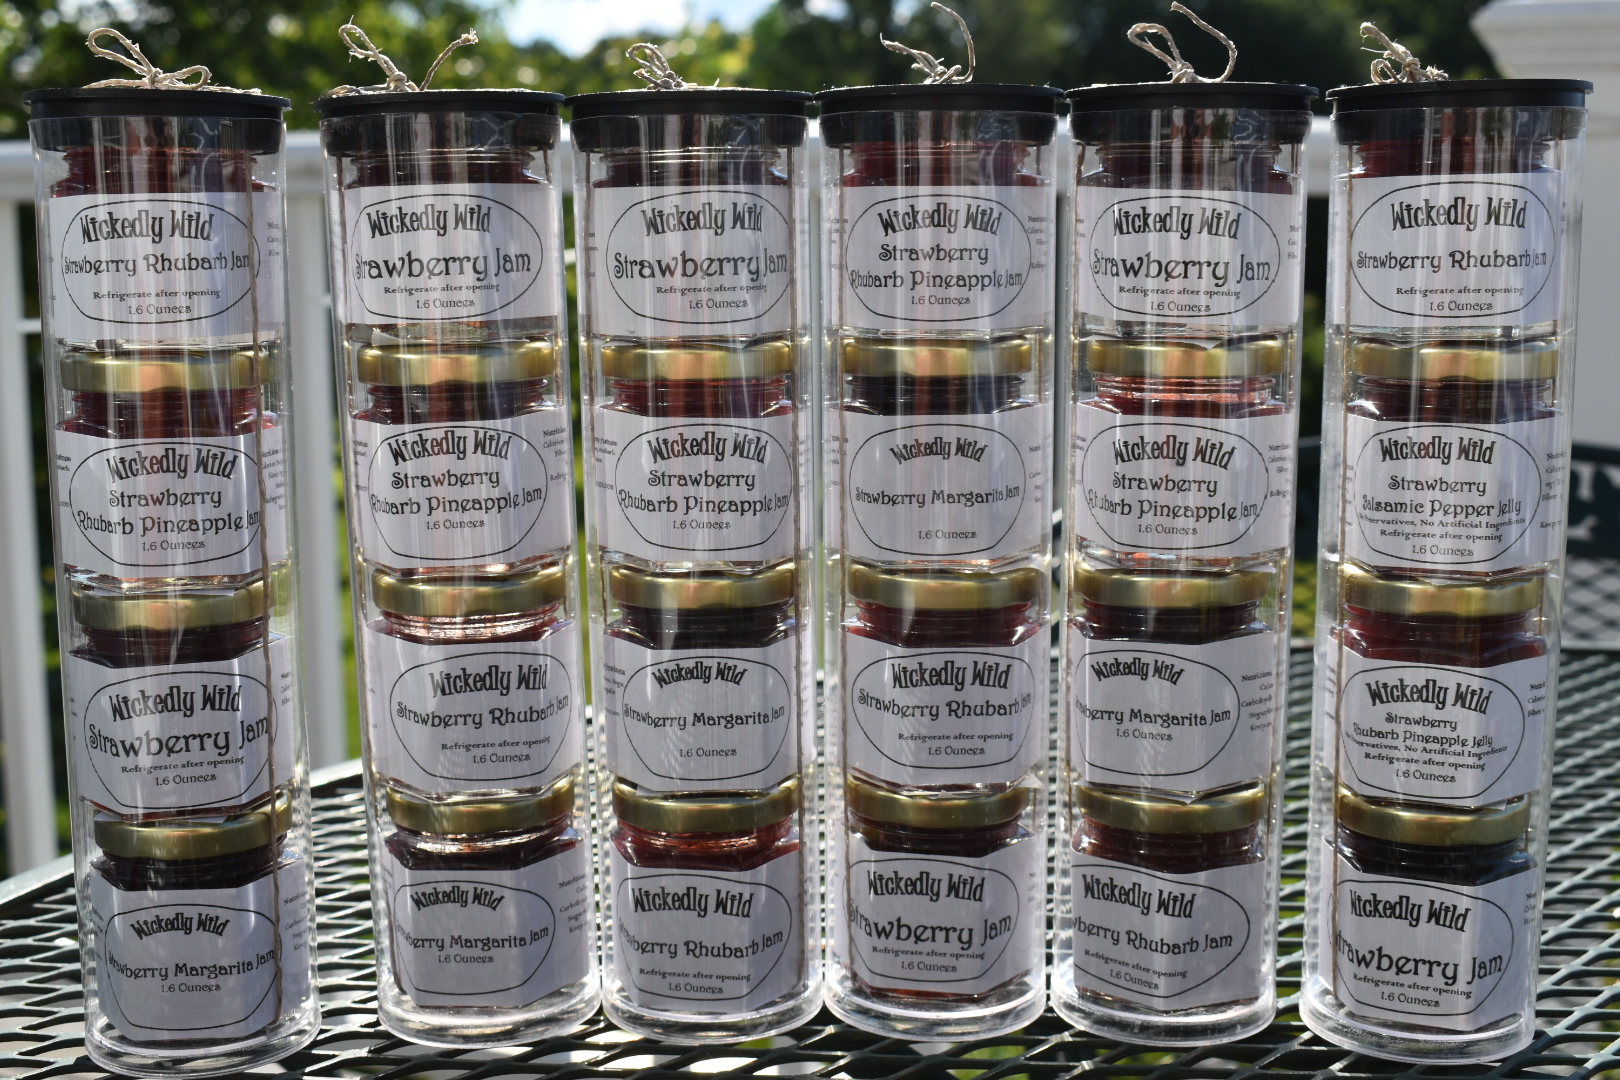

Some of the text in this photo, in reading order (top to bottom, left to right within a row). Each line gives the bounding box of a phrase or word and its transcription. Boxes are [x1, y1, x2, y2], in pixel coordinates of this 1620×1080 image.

[80, 209, 214, 244] Wickedly Wild
[367, 204, 492, 239] Wickedly Wild
[641, 203, 763, 236] Wickedly Wild
[877, 203, 1002, 236] Wickedly Wild
[1113, 206, 1241, 240] Wickedly Wild
[1391, 197, 1528, 231] Wickedly Wild
[64, 253, 227, 276] Strawberry Rhubarb
[494, 248, 531, 277] Jam
[614, 249, 787, 282] Strawberry Jam
[879, 244, 989, 264] Strawberry
[1357, 250, 1531, 273] Strawberry Rhubarb
[850, 270, 1003, 292] Rhubarb Pineapple
[1094, 249, 1270, 288] Strawberry Jam
[93, 291, 152, 301] Refrigerate
[182, 289, 221, 298] opening
[1396, 287, 1454, 297] Refrigerate
[1485, 286, 1524, 296] opening
[128, 304, 191, 315] 1.6 Ounces
[1151, 301, 1210, 313] 1.6 Ounces
[1430, 301, 1493, 312] 1.6 Ounces
[387, 430, 468, 466] Wickedly
[472, 430, 512, 460] Wild
[647, 431, 728, 464] Wickedly
[731, 433, 768, 464] Wild
[889, 437, 988, 465] Wickedly Wild
[1113, 435, 1189, 466] Wickedly
[1192, 437, 1237, 470] Wild
[1379, 436, 1497, 465] Wickedly Wild
[106, 448, 190, 483] Wickedly
[194, 448, 238, 480] Wild
[391, 470, 500, 489] Strawberry
[648, 470, 756, 491] Strawberry
[1113, 472, 1218, 497] Strawberry
[1388, 475, 1486, 496] Strawberry
[110, 489, 222, 508] Strawberry
[426, 487, 542, 516] Pineapple Jam
[618, 489, 772, 517] Rhubarb Pineapple
[855, 487, 1003, 508] Strawberry Margarita
[1429, 497, 1521, 518] Pepper Jelly
[77, 510, 243, 537] Rhubarb Pineapple
[1138, 499, 1237, 523] Pineapple
[426, 519, 485, 530] 1.6 Ounces
[672, 519, 731, 530] 1.6 Ounces
[1380, 529, 1503, 543] Refrigerate after opening
[1437, 520, 1482, 529] Artificial
[1412, 545, 1474, 557] 1.6 Ounces
[429, 664, 547, 698] Wickedly Wild
[652, 661, 748, 689] Wickedly Wild
[892, 660, 1012, 692] Wickedly Wild
[1091, 657, 1185, 685] Wickedly Wild
[109, 685, 241, 722] Wickedly Wild
[858, 688, 1019, 721] Strawberry Rhubarb
[1365, 679, 1449, 710] Wickedly
[1451, 683, 1493, 715] Wild
[397, 701, 554, 729] Strawberry Rhubarb
[624, 704, 770, 730] Strawberry Margarita
[1129, 709, 1231, 728] Margarita Jam
[1385, 712, 1458, 732] Strawberry
[89, 716, 268, 758] Strawberry Jam
[898, 732, 1013, 743] Refrigerate after opening
[1116, 728, 1172, 741] 1.6 Ounces
[1403, 730, 1493, 747] Pineapple Jelly
[928, 746, 985, 756] 1.6 Ounces
[1364, 752, 1486, 771] Refrigerate after opening
[1421, 746, 1465, 757] Artificial
[121, 756, 244, 774] Refrigerate after opening
[155, 774, 217, 786] 1.6 Ounces
[410, 886, 505, 911] Wickedly Wild
[867, 871, 985, 902] Wickedly Wild
[1082, 874, 1197, 918] Wickedly Wild
[632, 886, 754, 918] Wickedly Wild
[130, 912, 193, 940] Wickedly
[196, 913, 230, 936] Wild
[1426, 900, 1471, 932] Wild
[450, 926, 549, 951] Margarita Jam
[981, 915, 1011, 946] Jam
[1126, 930, 1233, 955] Rhubarb Jam
[684, 930, 783, 959] Rhubarb Jam
[872, 946, 924, 957] Refrigerate
[950, 951, 985, 961] opening
[174, 962, 253, 979] Margarita
[1466, 954, 1503, 985] Jam
[161, 983, 221, 993] 1.6 Ounces
[668, 983, 724, 994] 1.6 Ounces
[1353, 973, 1472, 999] Refrigerate after opening
[1380, 991, 1440, 1008] 1.6 Ounces
